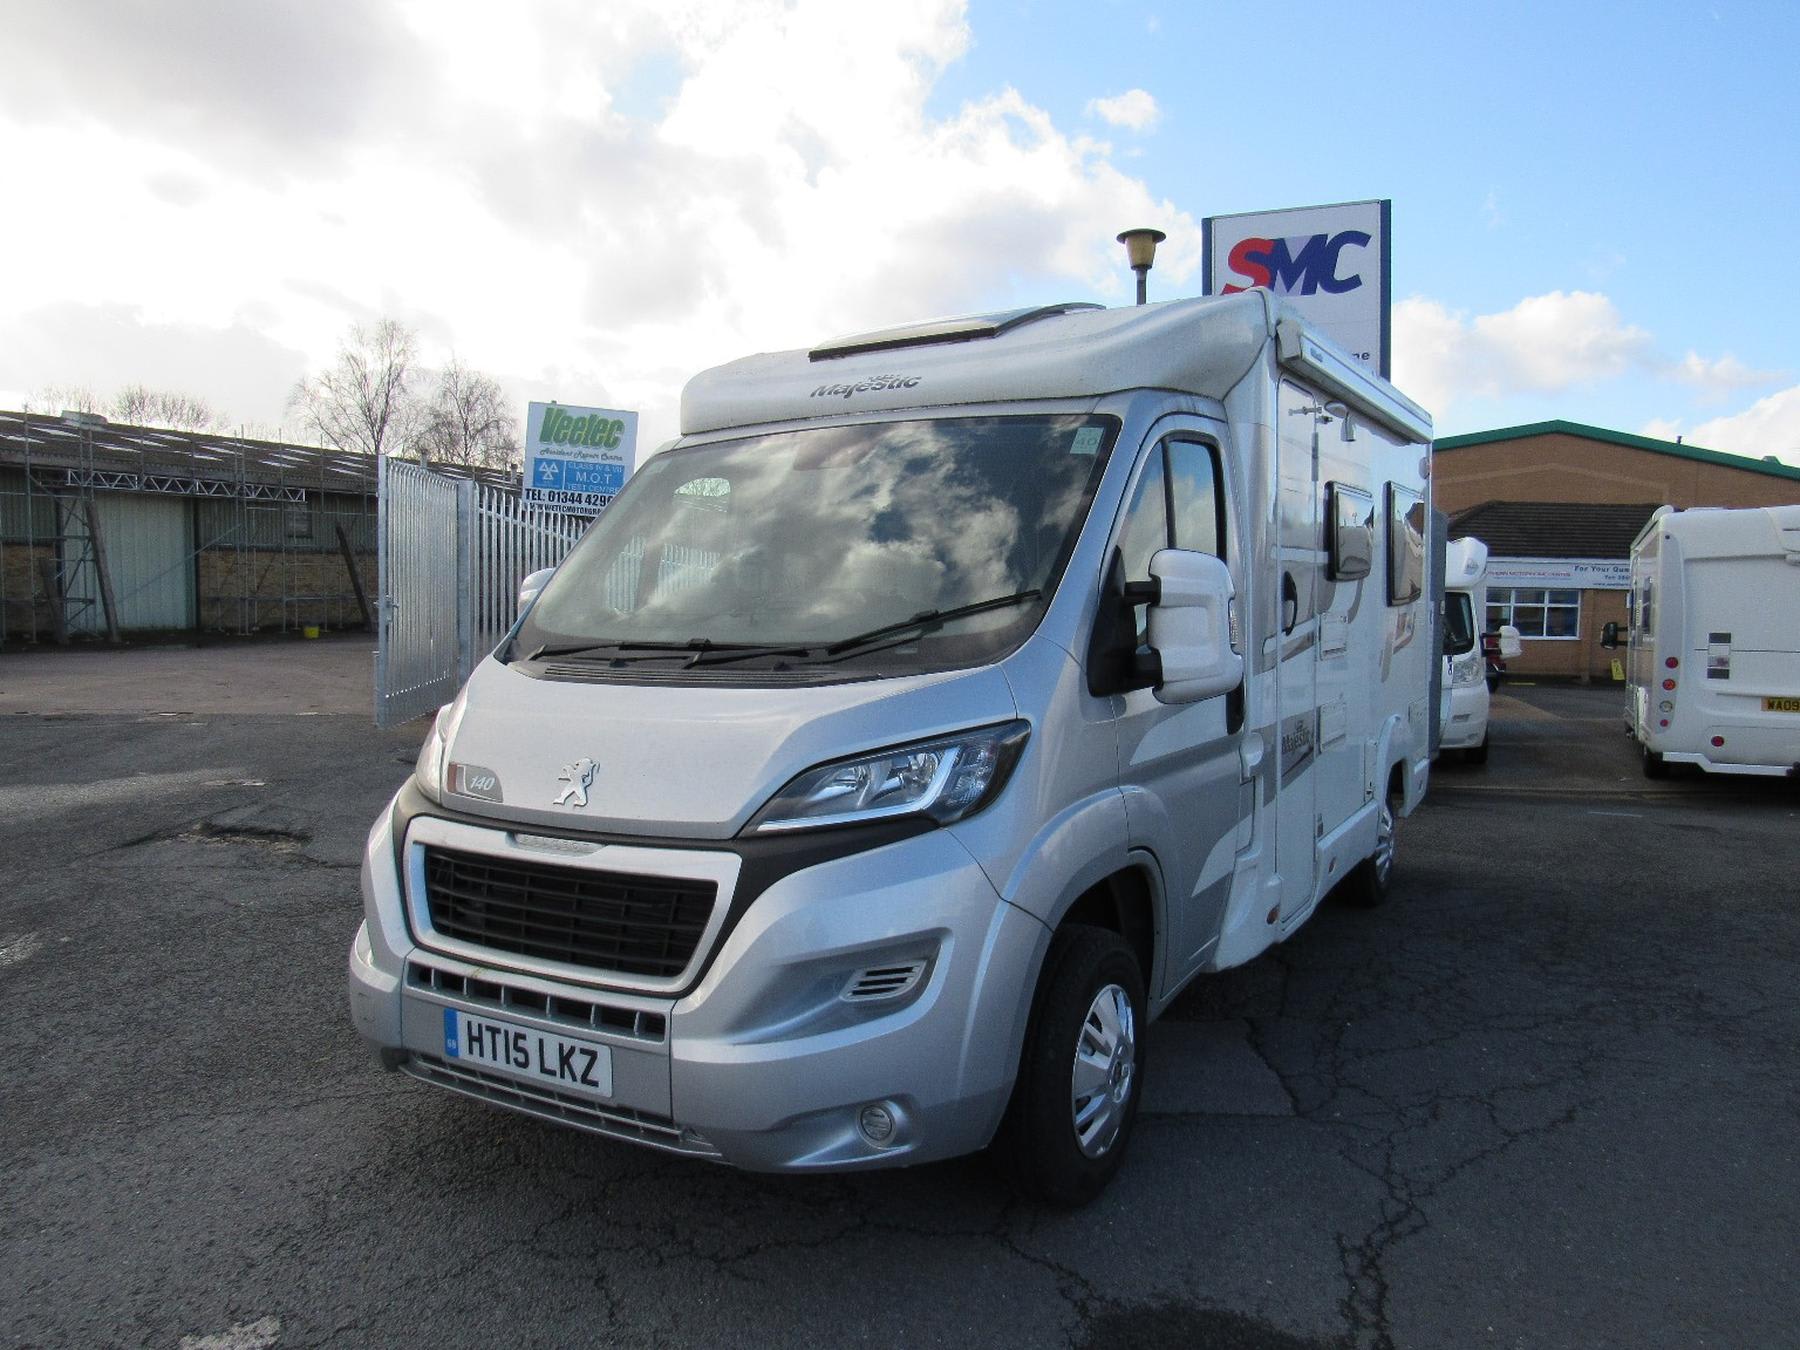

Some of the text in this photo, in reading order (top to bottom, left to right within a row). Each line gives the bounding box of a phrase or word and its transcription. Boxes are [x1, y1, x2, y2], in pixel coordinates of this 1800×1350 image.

[1221, 230, 1372, 295] SMC
[810, 376, 922, 399] Majestic
[539, 407, 625, 450] Veetec
[525, 488, 546, 502] TEL:
[548, 490, 583, 505] 01344
[470, 775, 496, 791] 140
[467, 1020, 600, 1088] HT15 LKZ
